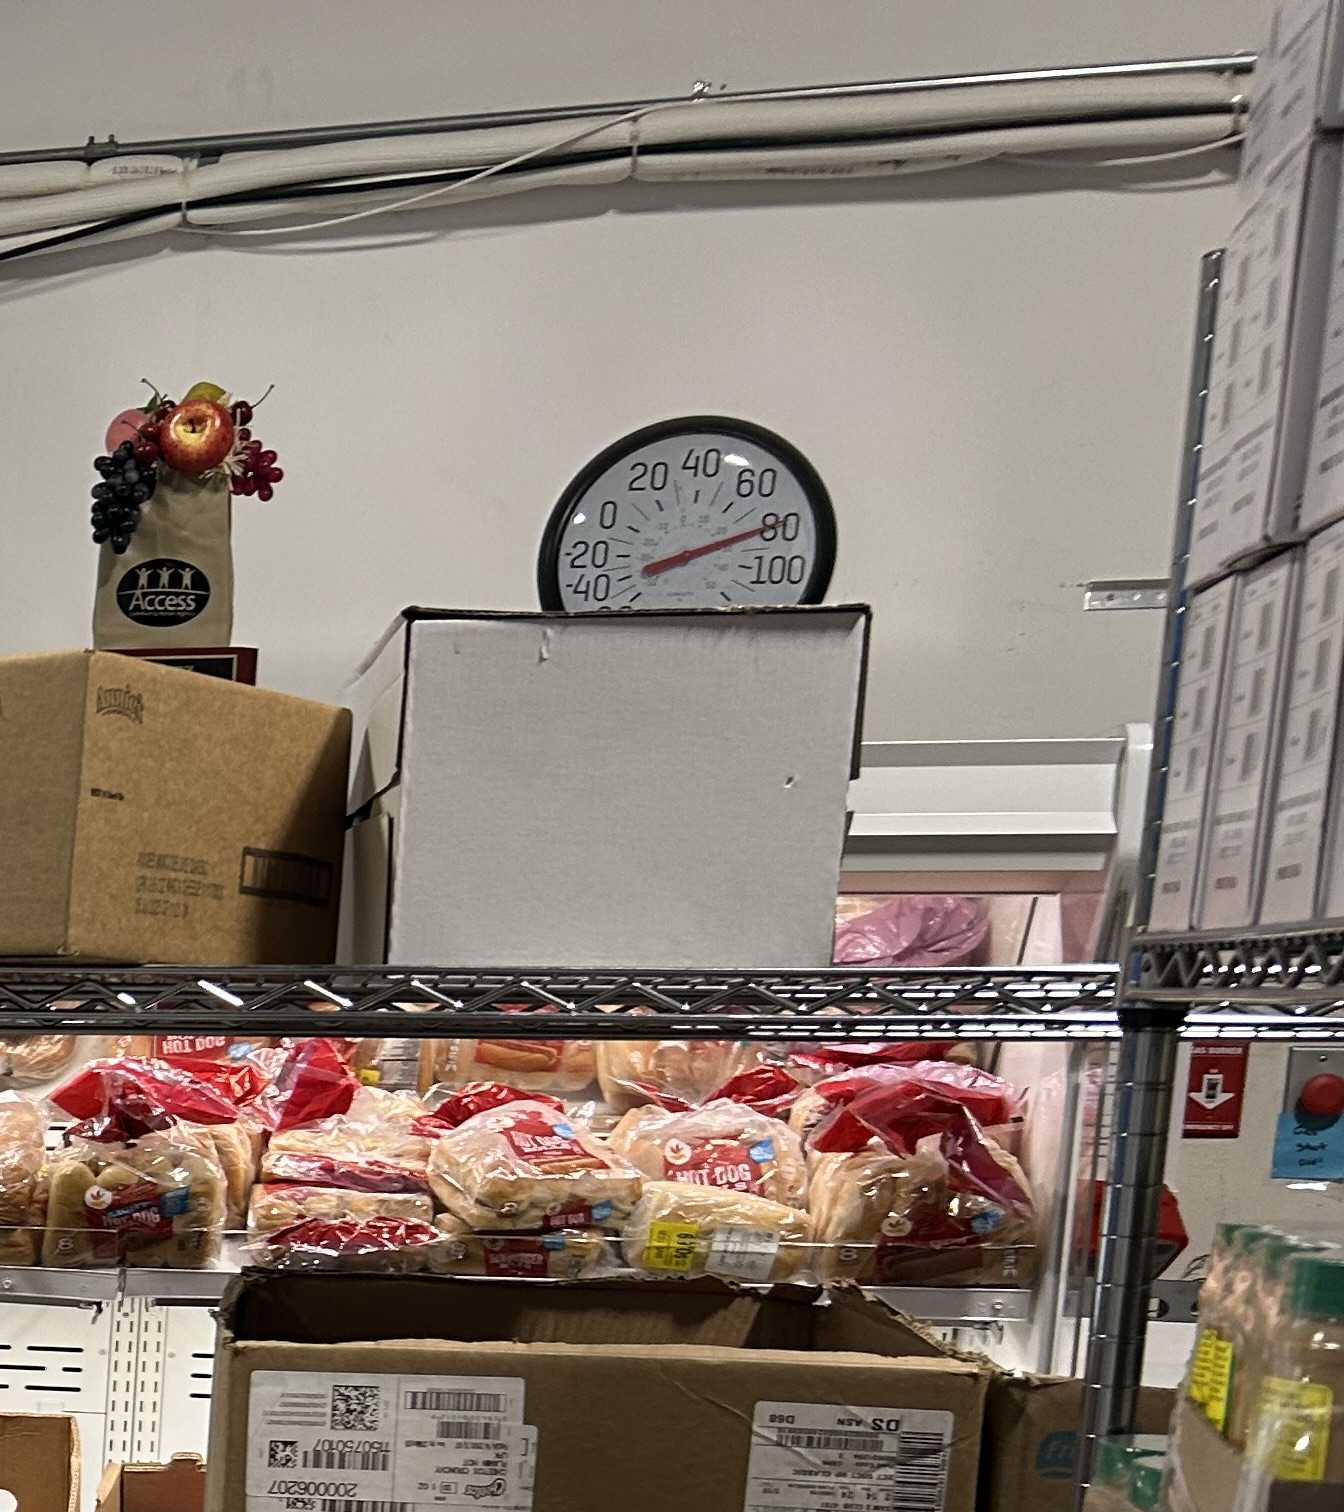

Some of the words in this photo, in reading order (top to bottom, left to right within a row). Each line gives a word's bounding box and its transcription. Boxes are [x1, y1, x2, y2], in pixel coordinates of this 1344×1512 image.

[628, 462, 668, 491] 20
[681, 448, 721, 478] 40
[736, 467, 777, 498] 60
[599, 501, 618, 529] 0
[760, 512, 800, 542] 80
[565, 540, 609, 569] -20
[750, 555, 806, 585] 100
[128, 589, 196, 611] Access
[715, 1163, 752, 1185] DOG
[872, 1417, 900, 1432] DS
[266, 1479, 358, 1498] 200006207
